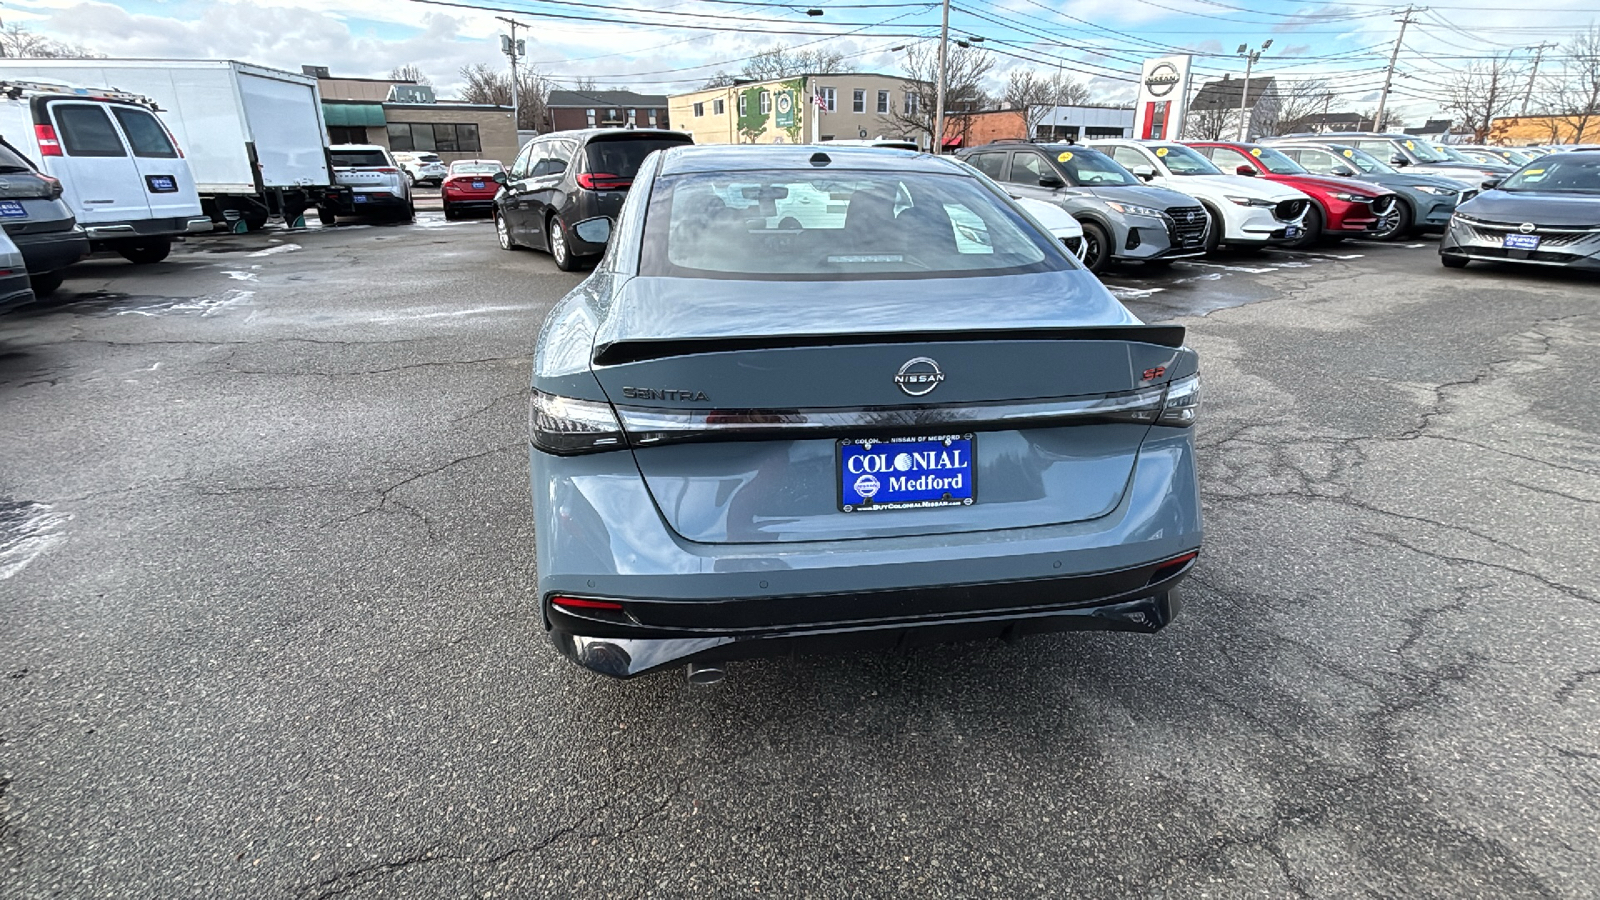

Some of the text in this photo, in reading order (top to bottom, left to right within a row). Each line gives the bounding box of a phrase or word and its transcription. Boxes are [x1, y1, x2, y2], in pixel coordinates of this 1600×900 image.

[894, 374, 945, 383] NISSAN
[1142, 366, 1166, 381] SR
[622, 386, 710, 402] SENTRA
[847, 450, 968, 474] COLONIAL
[888, 473, 963, 492] Medford
